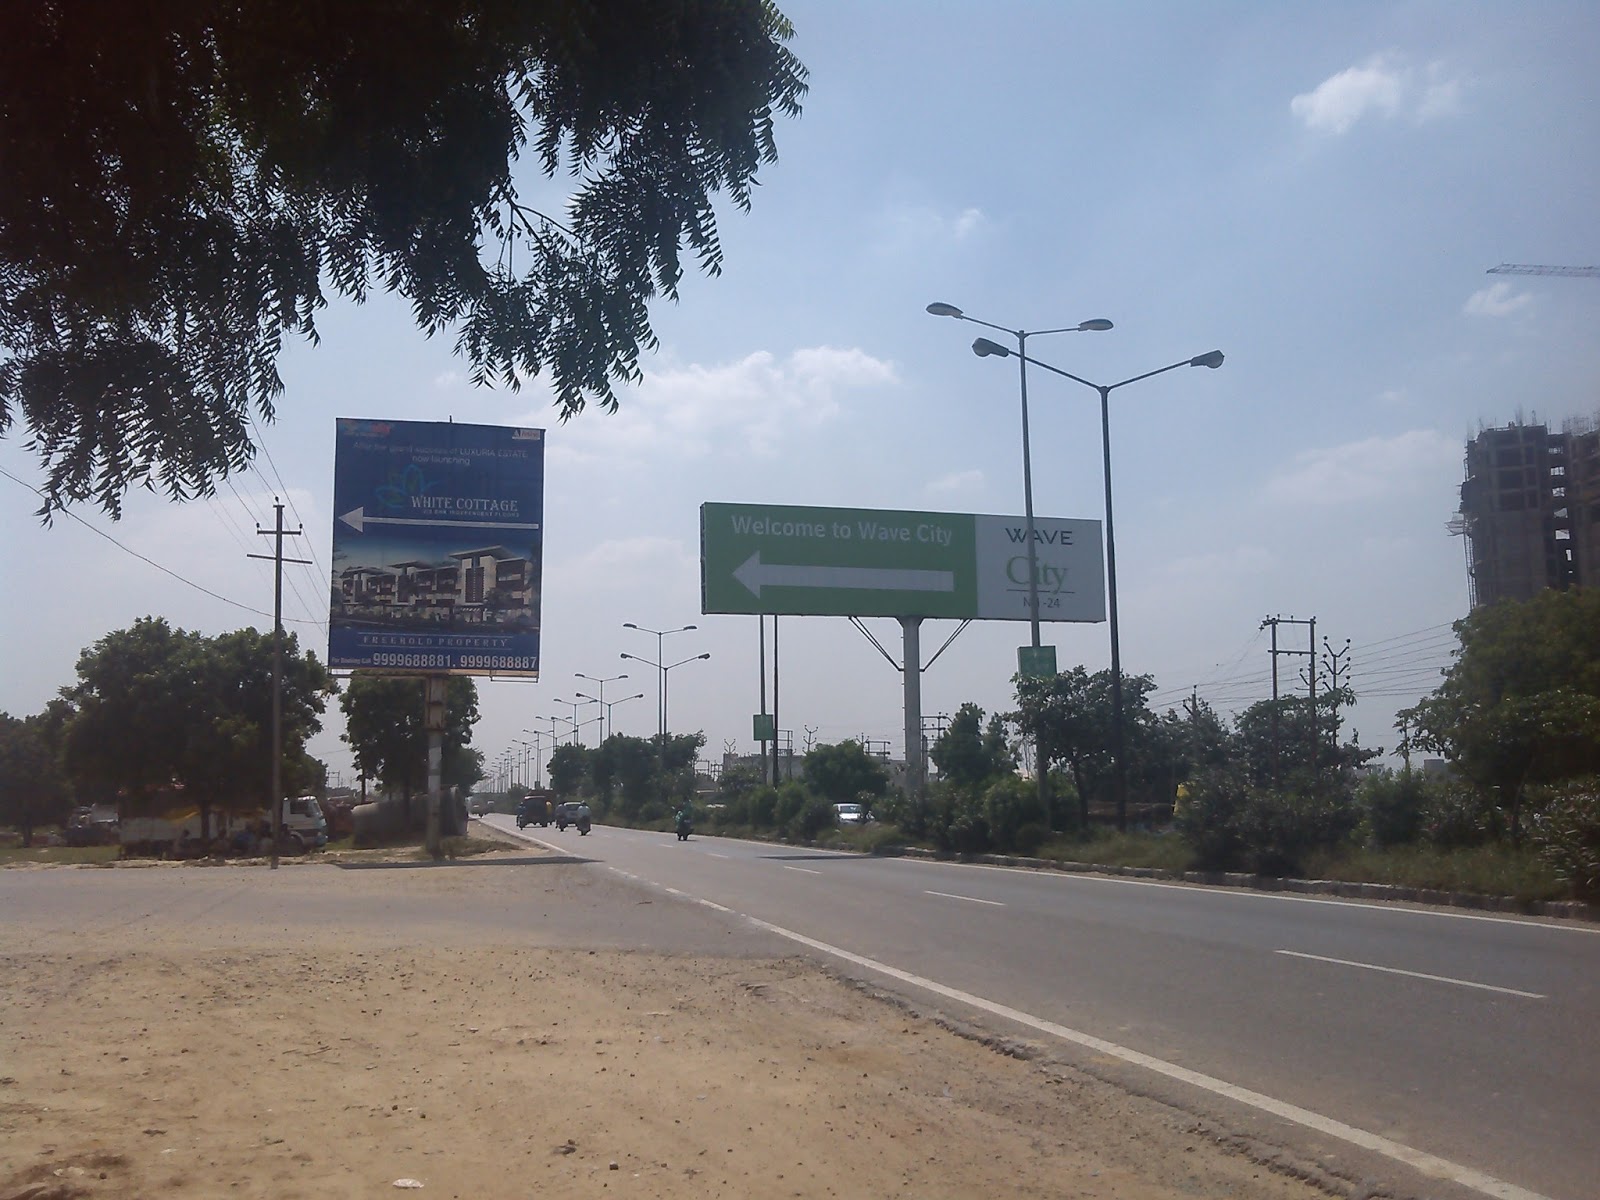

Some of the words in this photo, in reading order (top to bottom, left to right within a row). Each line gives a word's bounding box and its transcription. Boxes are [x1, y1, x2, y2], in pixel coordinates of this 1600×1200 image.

[460, 447, 496, 457] LUXURIA
[412, 455, 430, 463] now
[431, 454, 471, 466] launching
[411, 495, 453, 509] WHITE
[456, 497, 519, 512] COTTAGE
[731, 515, 826, 538] Welcome
[832, 522, 851, 539] to
[858, 521, 911, 541] Wave
[916, 523, 953, 546] City
[1005, 527, 1073, 546] WAVE
[363, 636, 433, 646] FREEHOLD
[438, 637, 508, 647] PROPERTY
[460, 654, 537, 669] 9999688887
